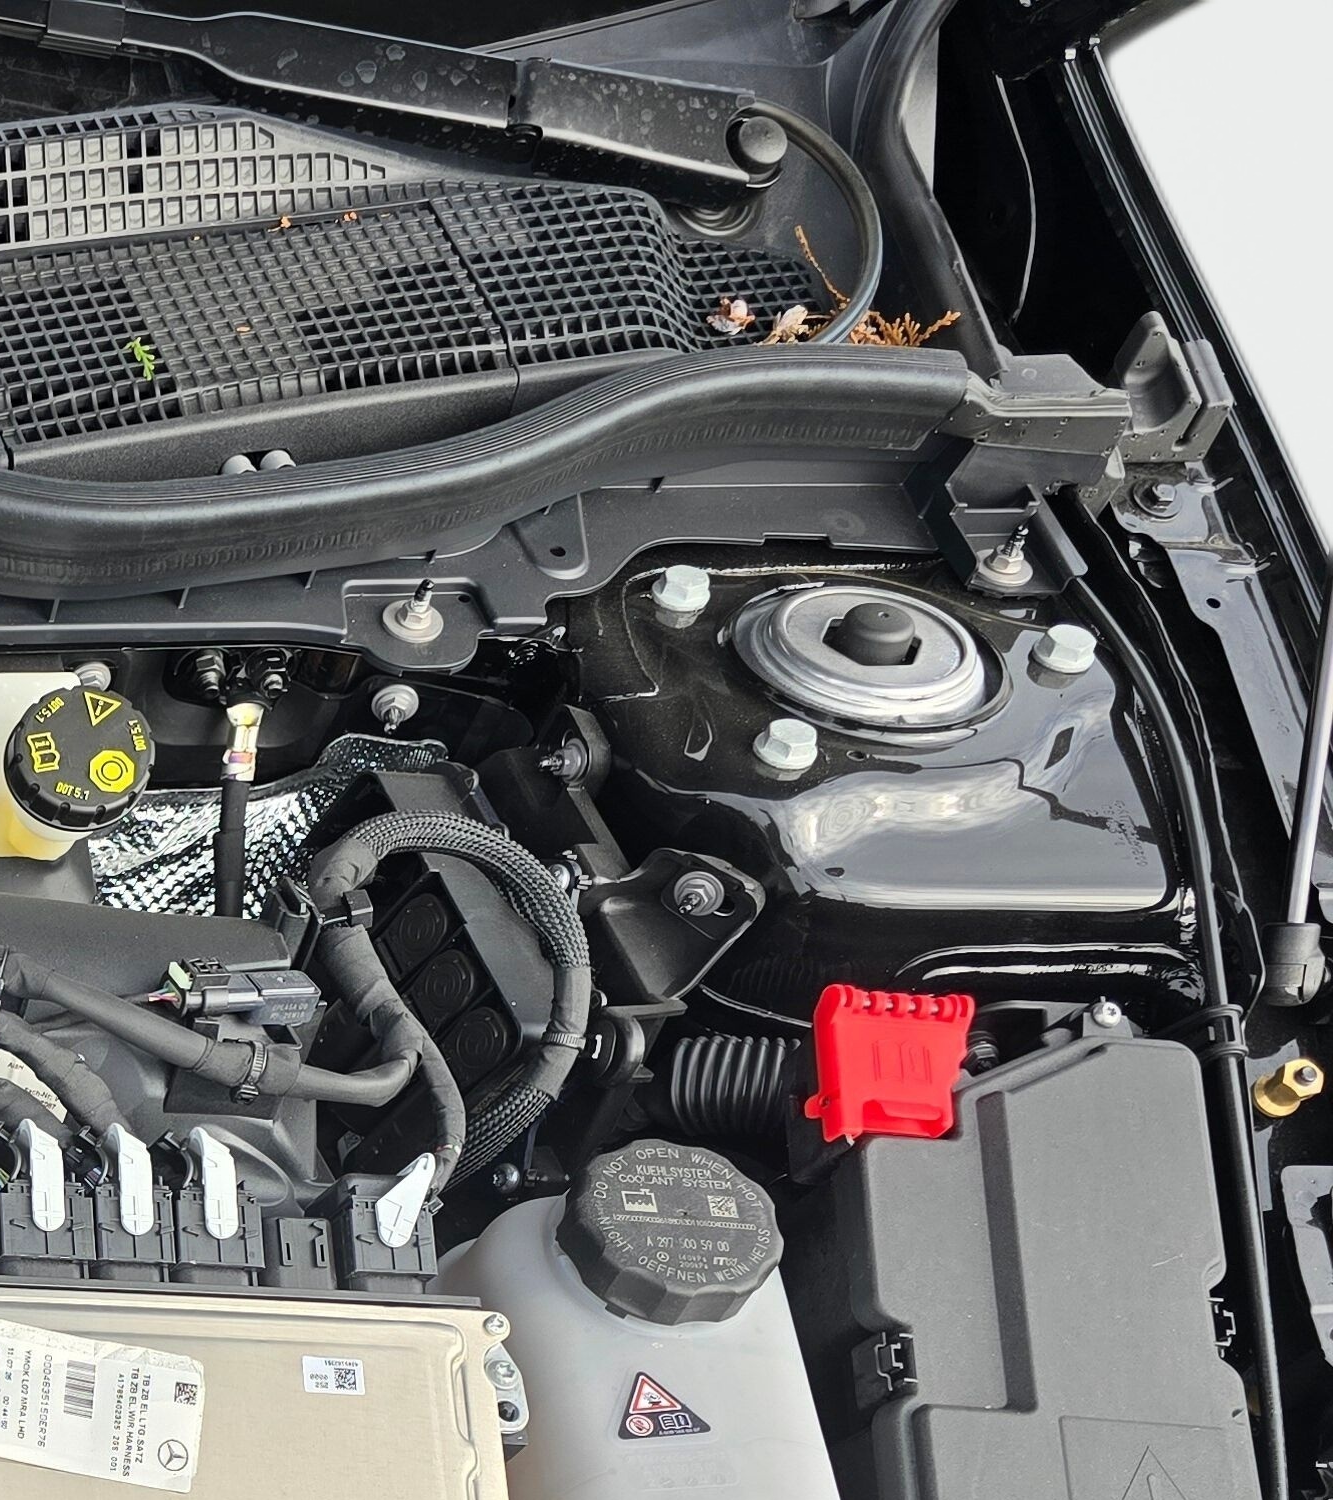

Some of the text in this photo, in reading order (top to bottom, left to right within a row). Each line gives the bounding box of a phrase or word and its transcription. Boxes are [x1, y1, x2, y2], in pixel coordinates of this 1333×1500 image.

[35, 696, 65, 723] DOT 5.1
[56, 781, 90, 800] DOT 5.1
[593, 1147, 765, 1209] DO NOT OPEN WHEN HOT
[635, 1165, 714, 1179] KUEHLSYSTEM
[618, 1174, 732, 1190] COOLANT SYSTEM
[598, 1215, 771, 1284] NICHT OEFFNEN WENN HEISS
[646, 1236, 654, 1247] A
[656, 1236, 674, 1249] 297
[700, 1239, 713, 1250] 59
[717, 1240, 730, 1252] 00
